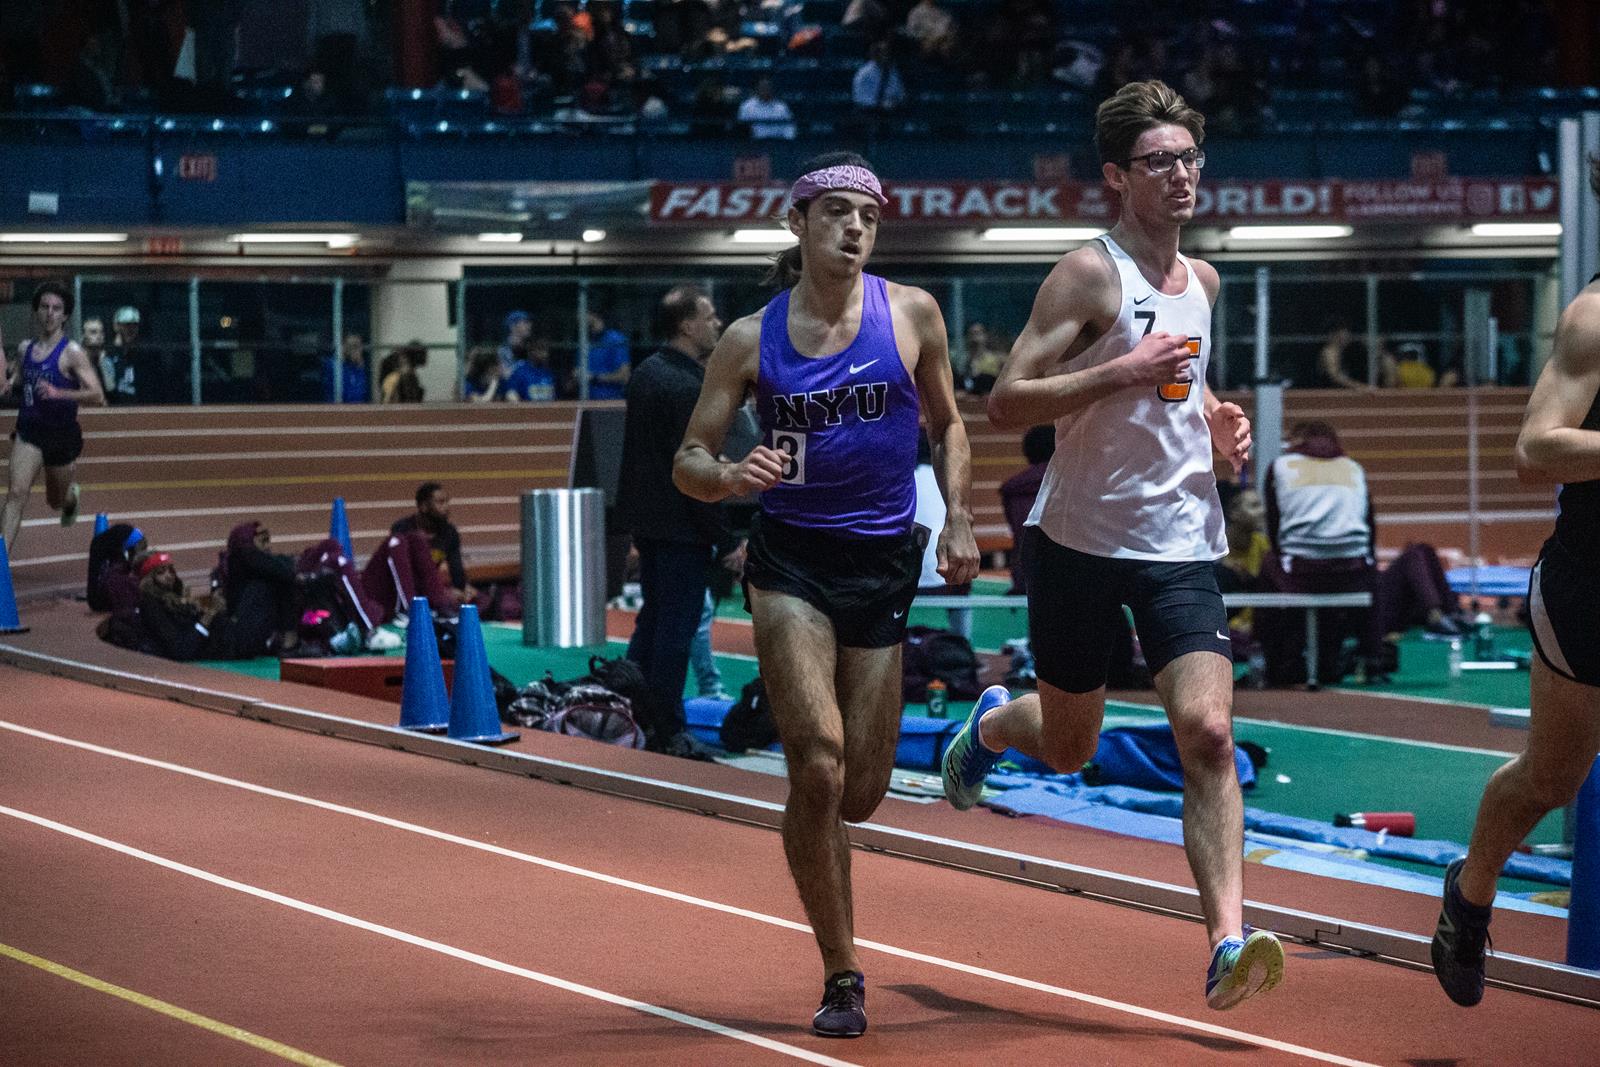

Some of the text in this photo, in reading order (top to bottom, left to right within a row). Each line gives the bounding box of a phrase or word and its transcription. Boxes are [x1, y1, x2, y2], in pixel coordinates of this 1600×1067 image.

[892, 186, 1059, 216] TRACK
[1195, 185, 1331, 215] ORLD!
[1134, 311, 1156, 339] 7
[772, 381, 888, 428] NYU
